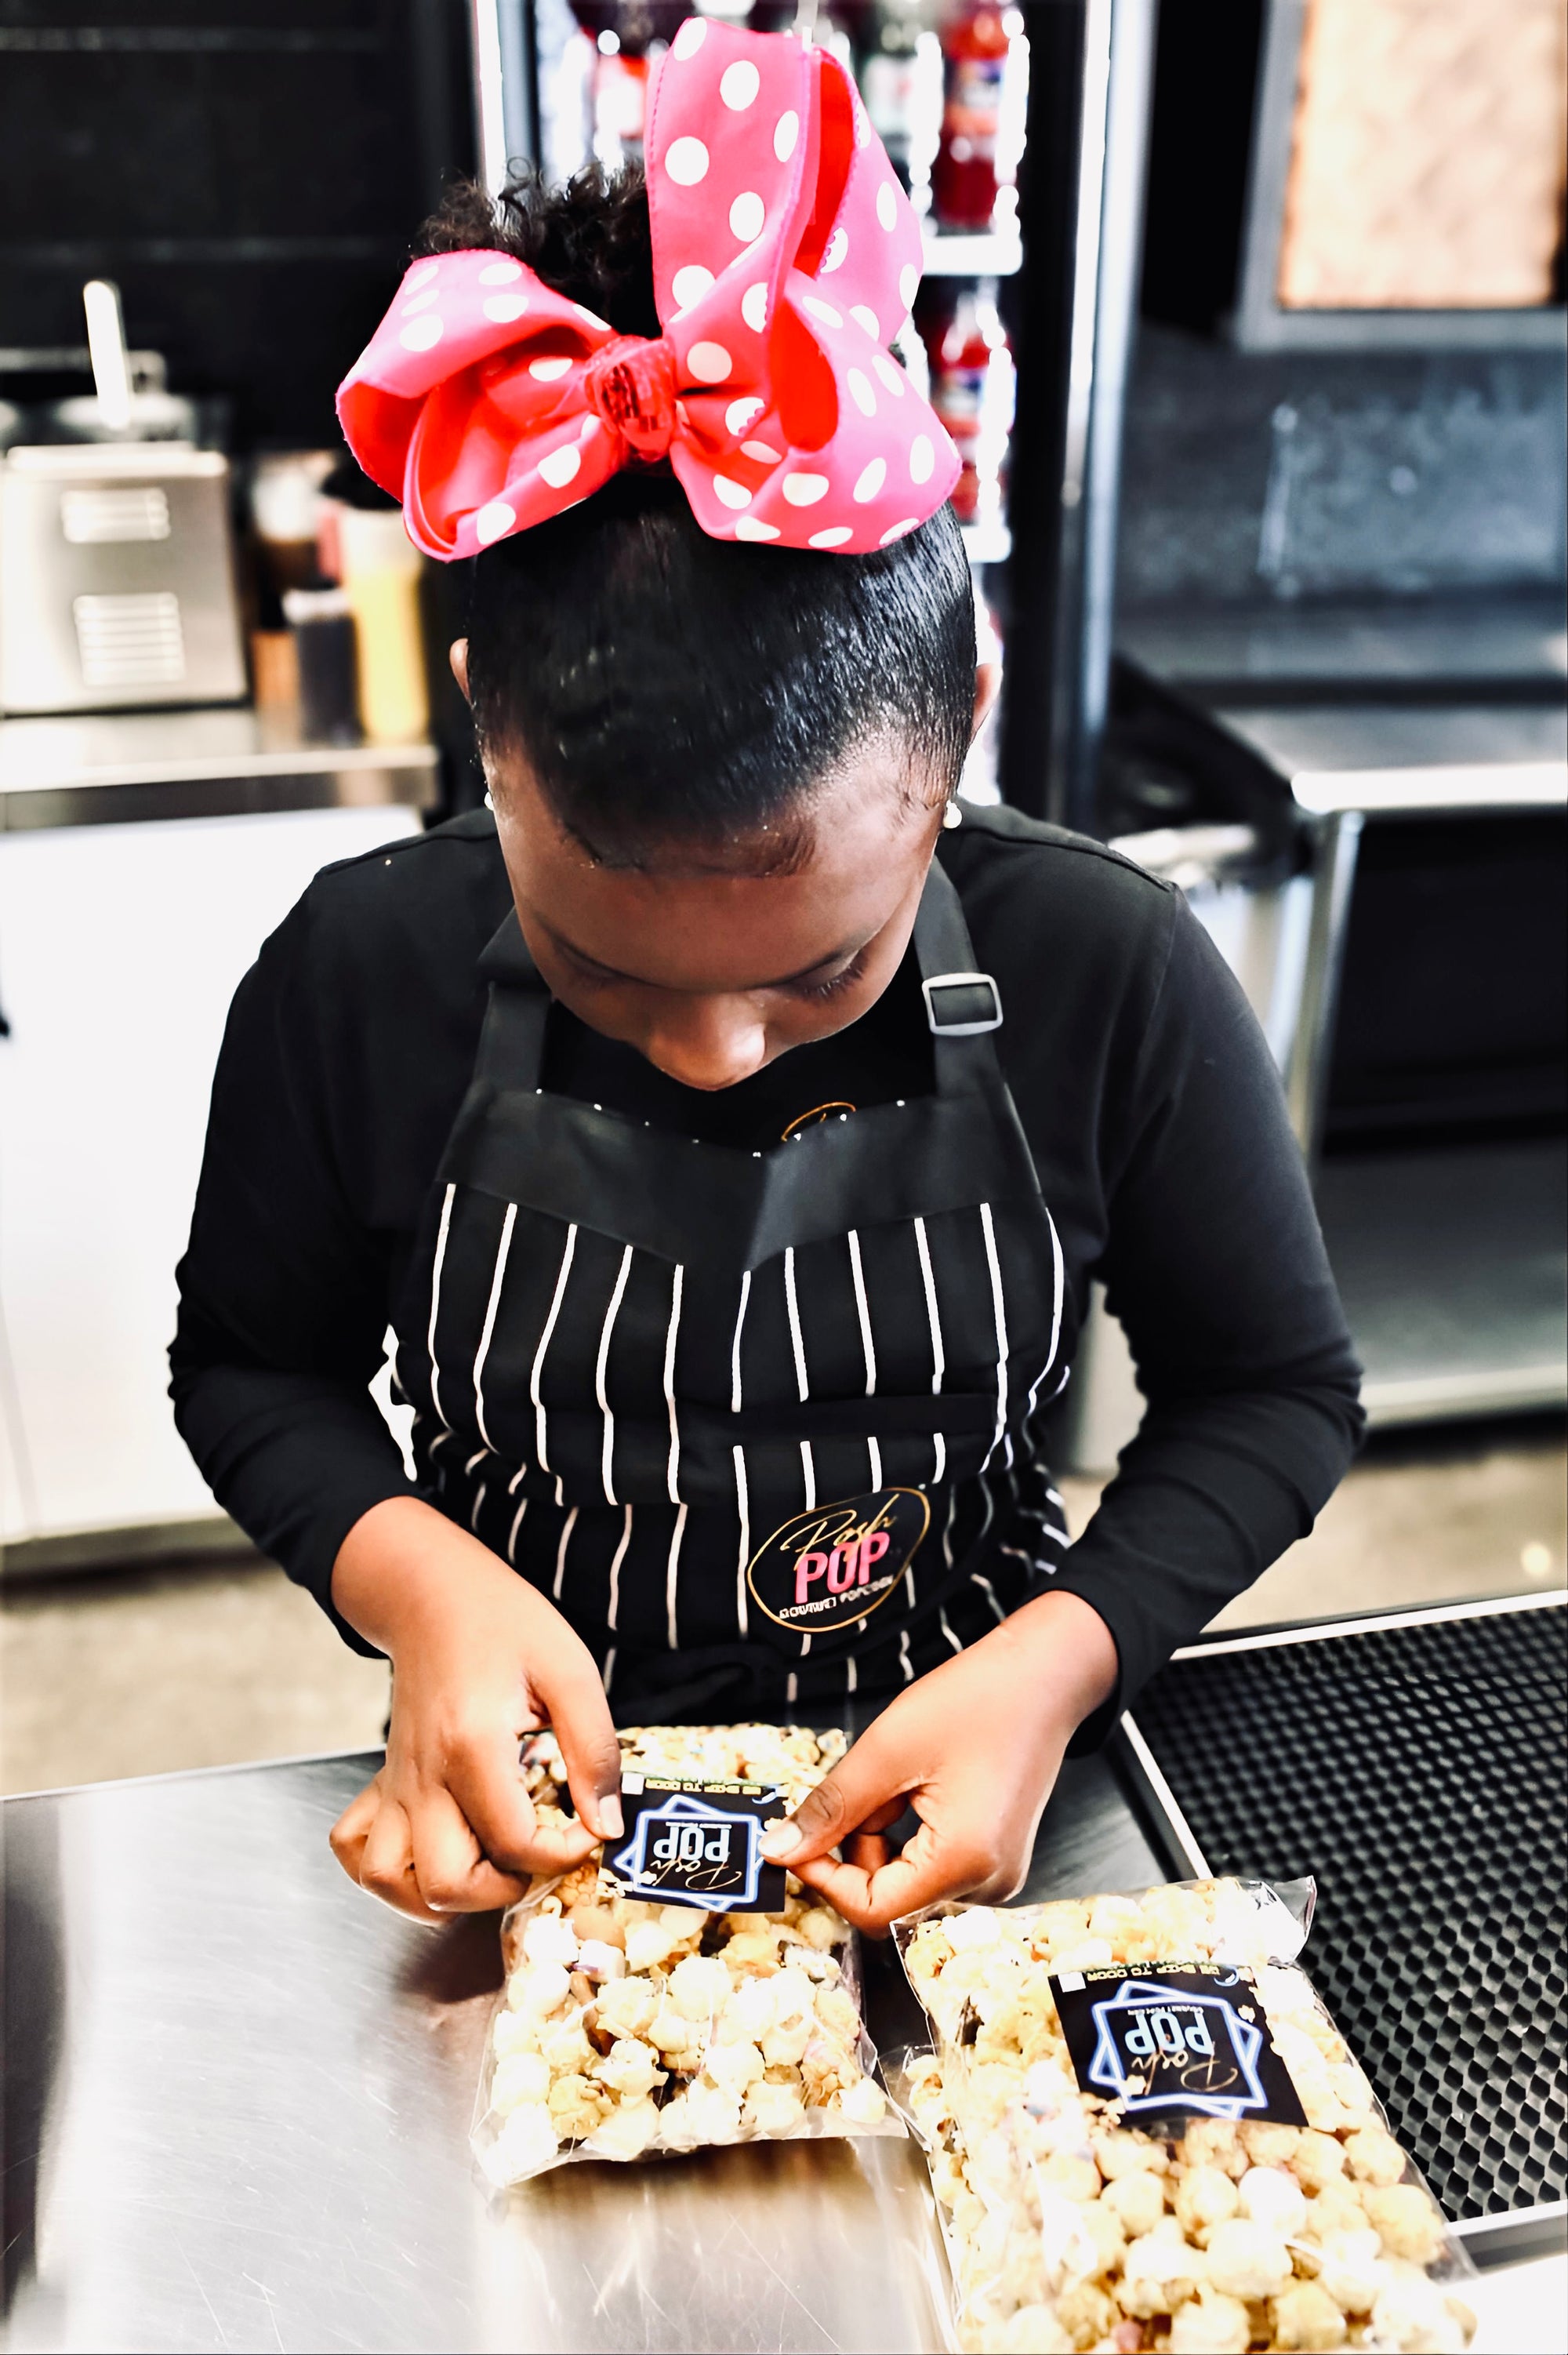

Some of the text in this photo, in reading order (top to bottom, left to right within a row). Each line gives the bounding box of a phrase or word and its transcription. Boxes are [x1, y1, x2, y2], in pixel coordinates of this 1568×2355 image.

[780, 1492, 900, 1571] Posh
[794, 1531, 891, 1604] POP
[653, 1826, 730, 1863] POP
[649, 1847, 742, 1891] Posh
[1131, 1967, 1152, 1976] TO
[1124, 2012, 1215, 2055] POP
[1131, 2034, 1238, 2095] Posh
